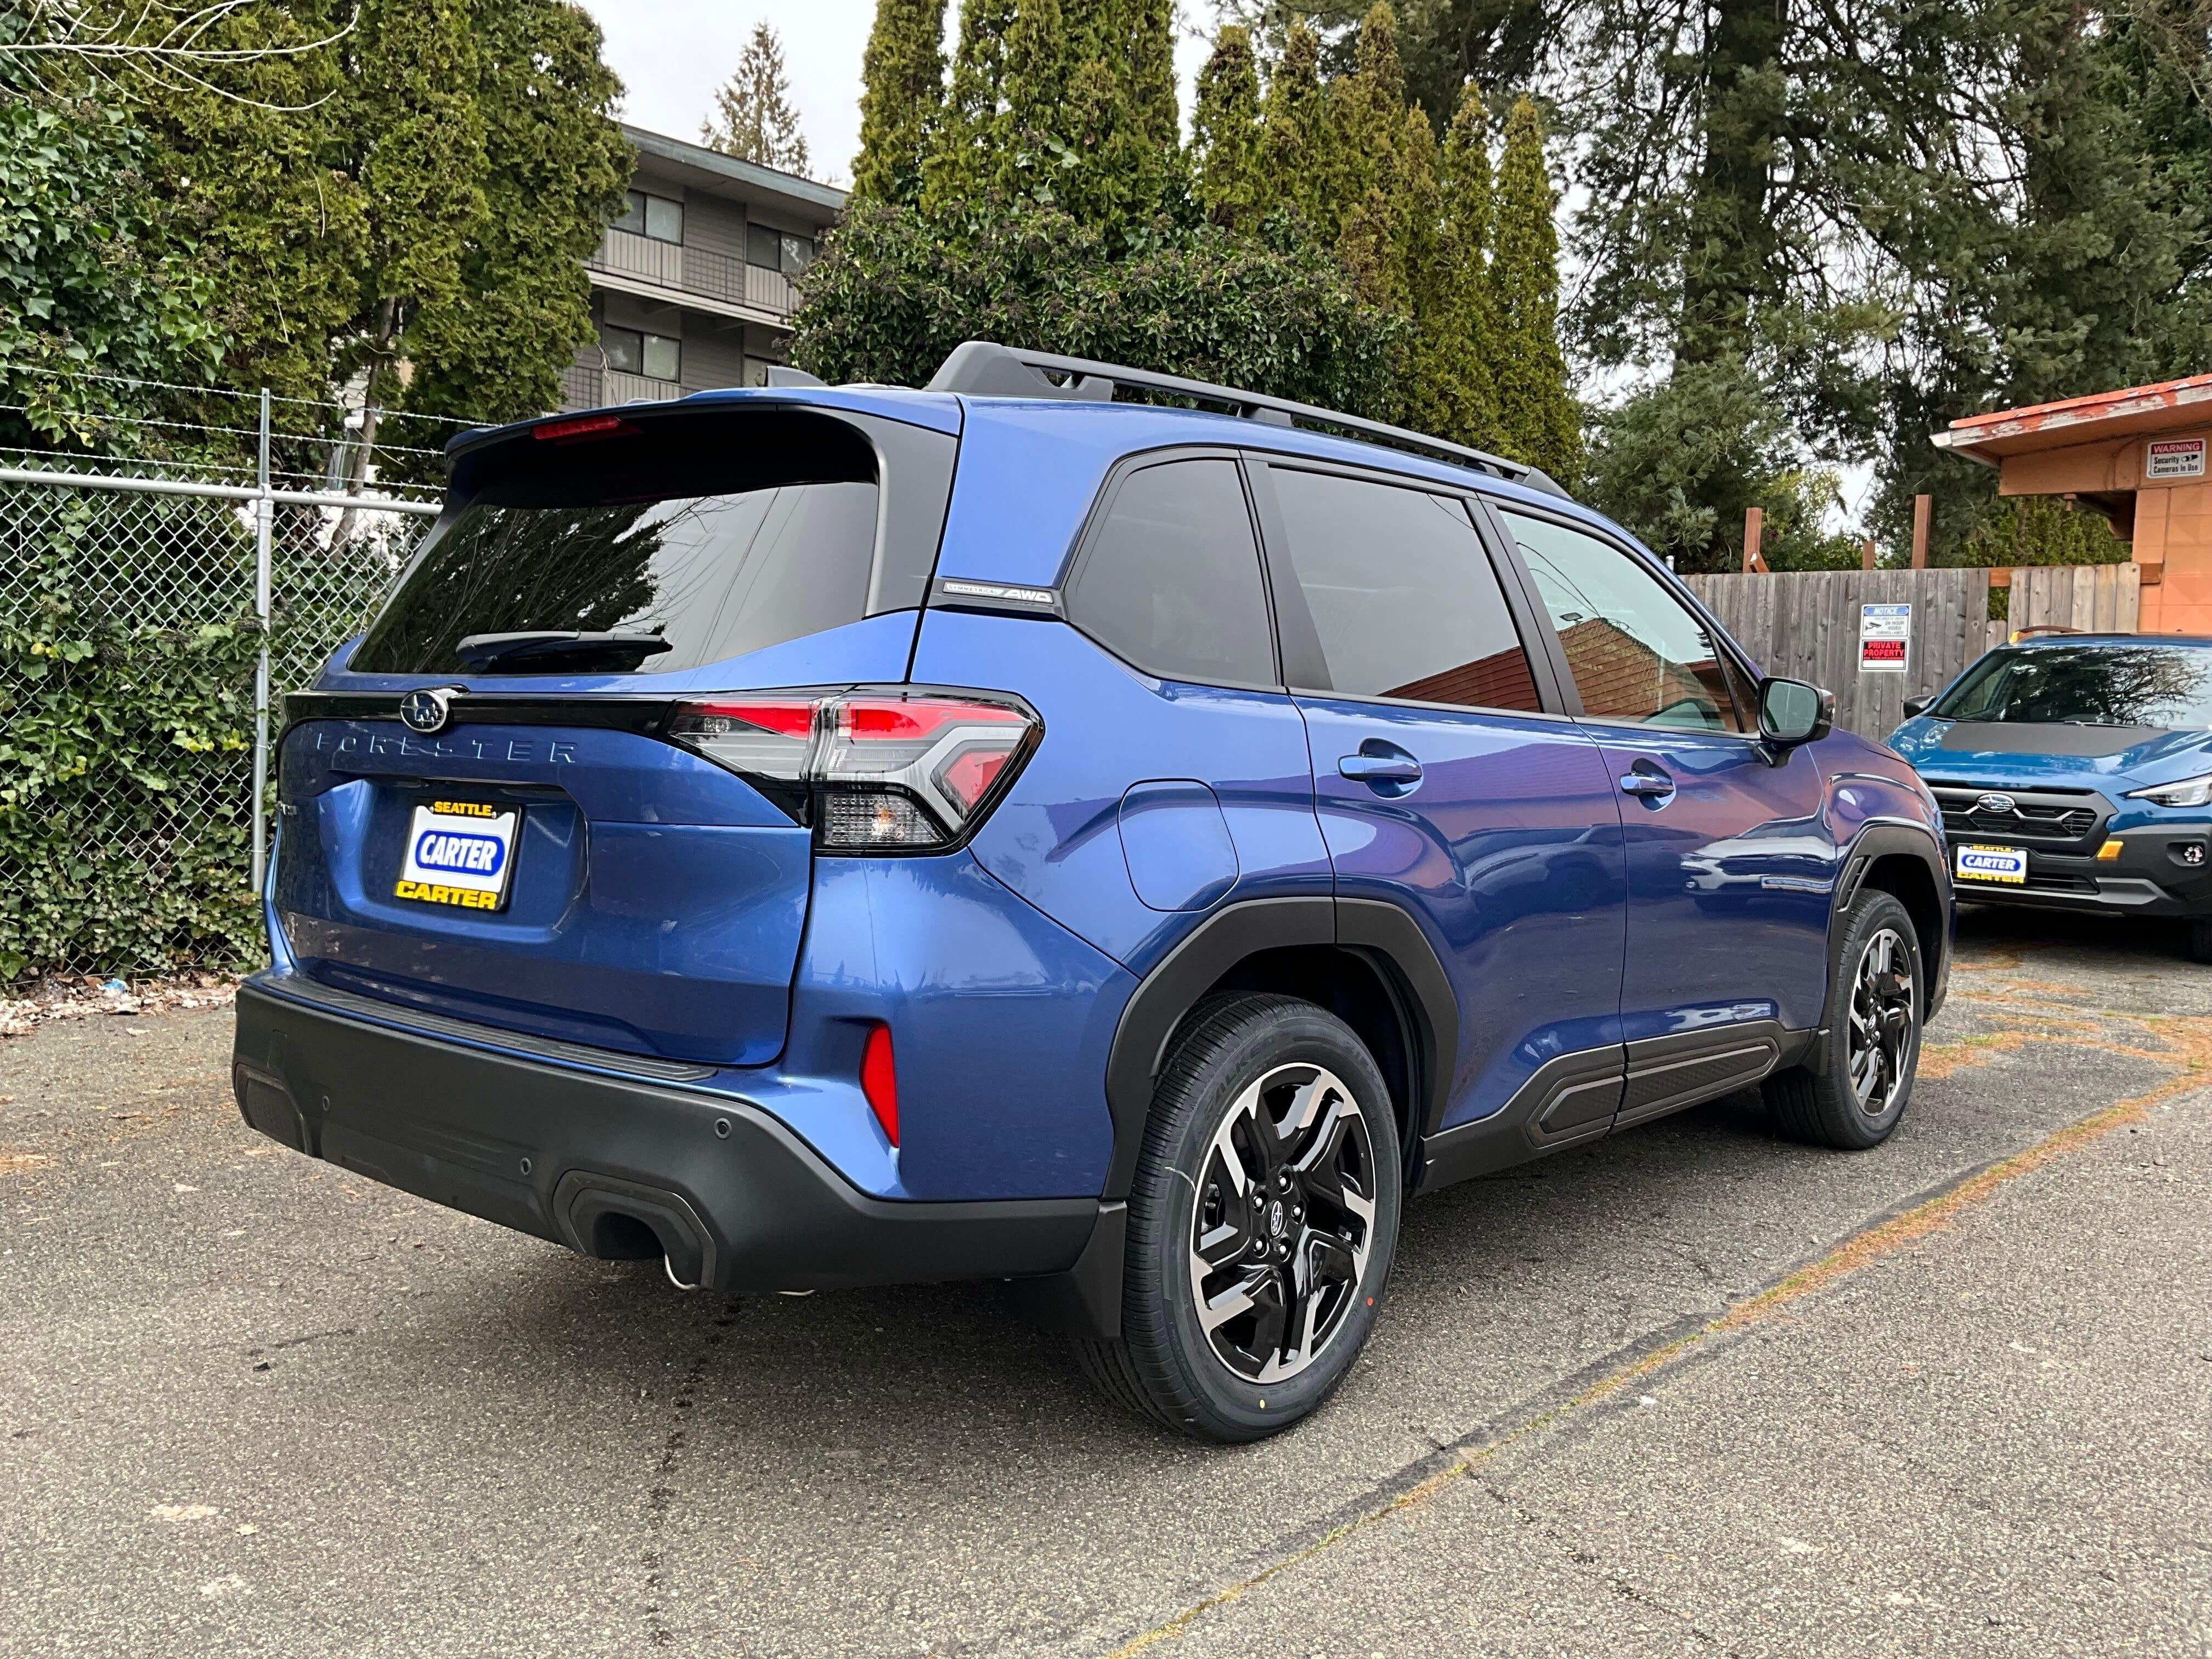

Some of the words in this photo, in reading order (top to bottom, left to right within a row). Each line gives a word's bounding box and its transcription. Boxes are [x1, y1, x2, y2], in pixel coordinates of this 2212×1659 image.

[2153, 443, 2200, 453] WARNING
[2154, 456, 2180, 465] Security
[949, 584, 999, 595] SYMMETRICAL
[1003, 589, 1054, 603] AWD
[316, 732, 577, 764] FORESTER
[434, 801, 493, 816] SEATTLE
[420, 834, 498, 871] CARTER
[1965, 856, 2016, 870] CARTER
[1957, 871, 2024, 884] CARTER
[396, 880, 498, 910] CARTER
